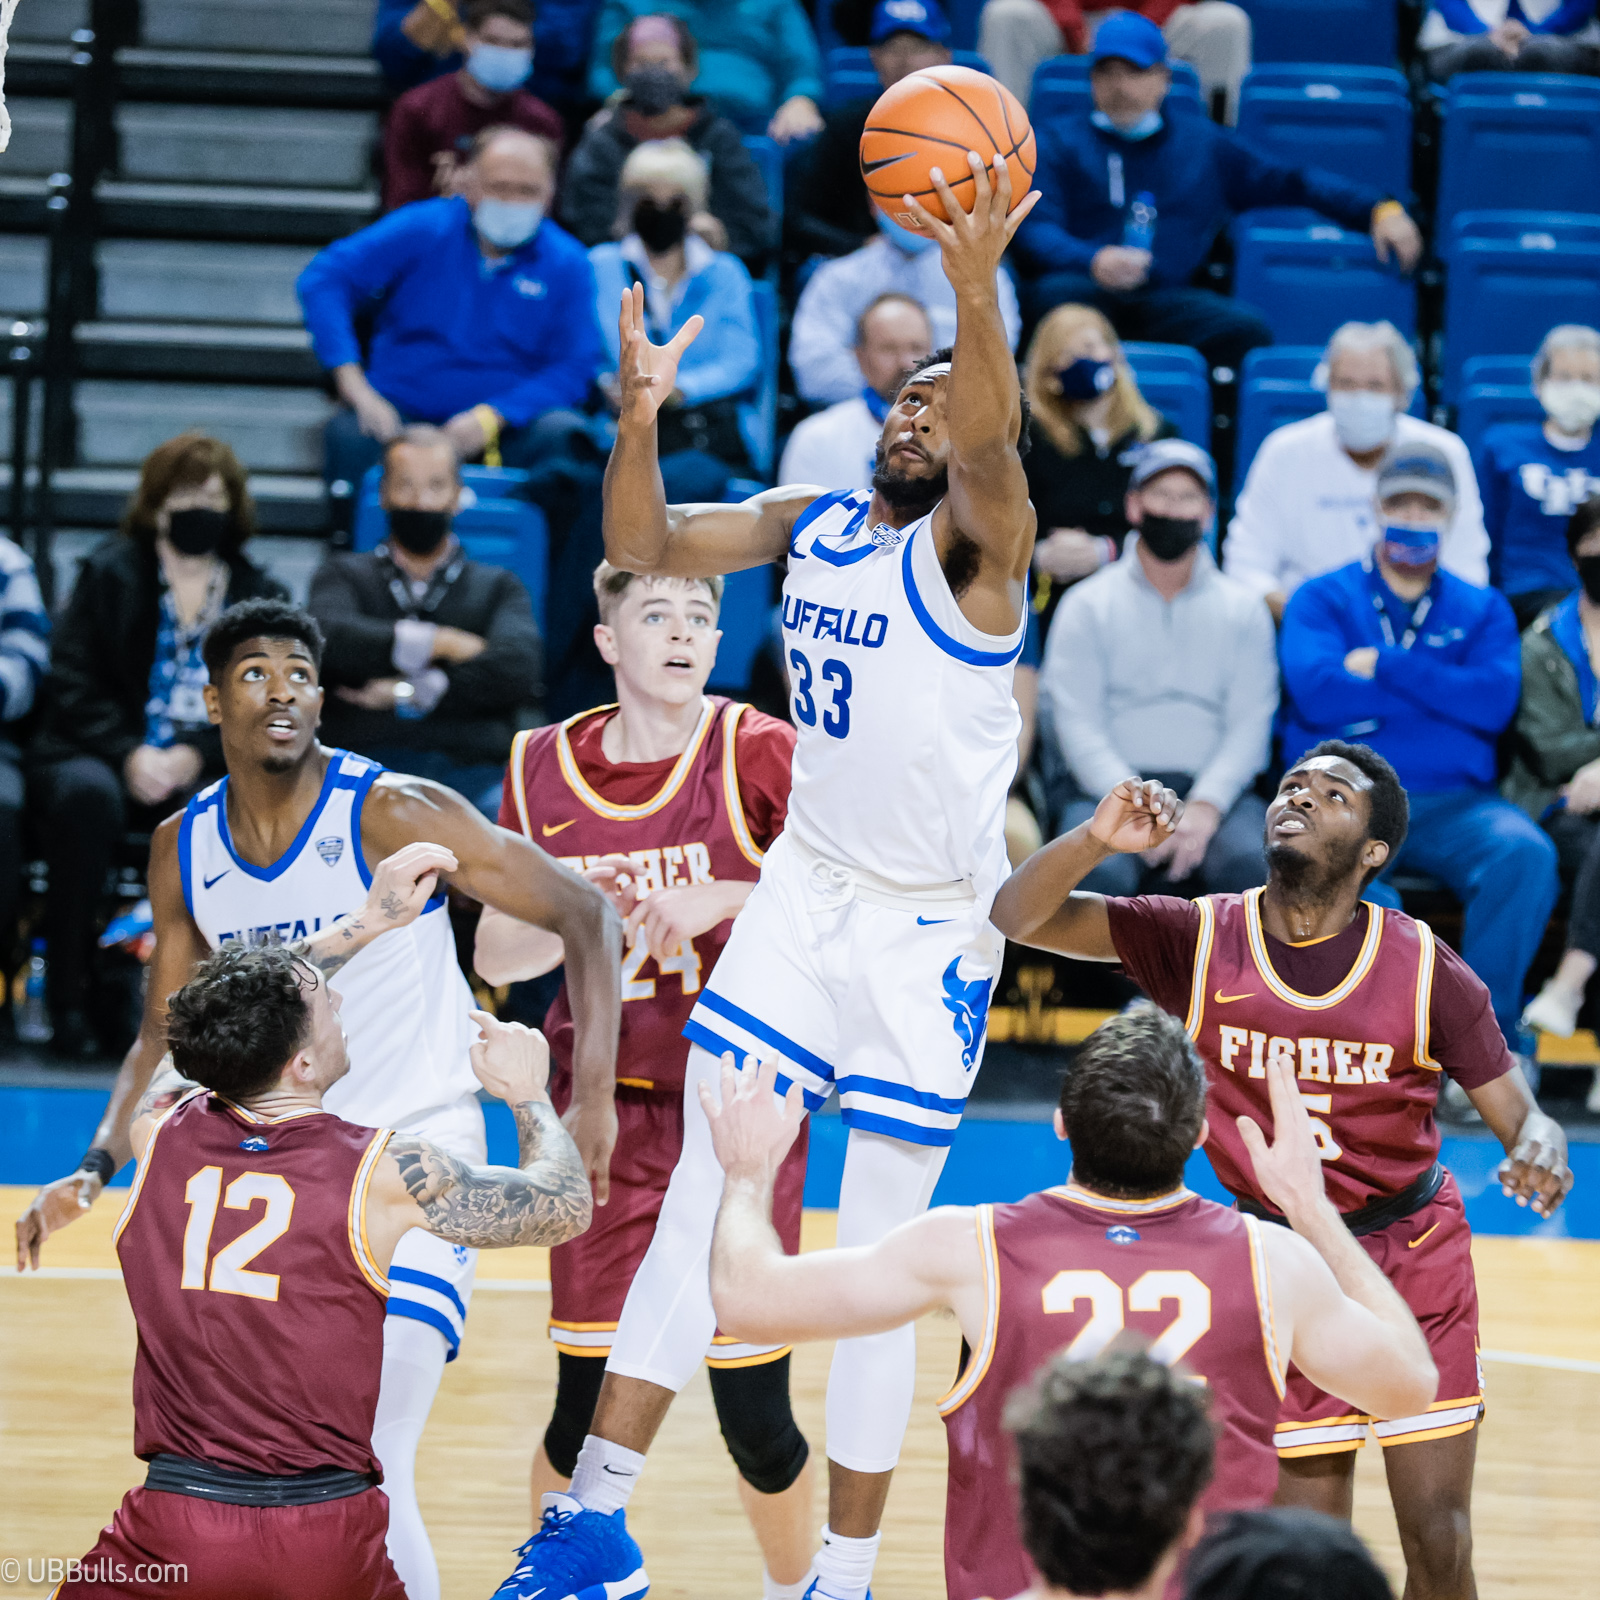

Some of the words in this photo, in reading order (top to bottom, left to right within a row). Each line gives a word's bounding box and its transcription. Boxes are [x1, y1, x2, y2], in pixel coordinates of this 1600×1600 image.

[789, 648, 853, 740] 33
[620, 916, 702, 1002] 24
[181, 1165, 296, 1302] 12
[1041, 1269, 1212, 1388] 22
